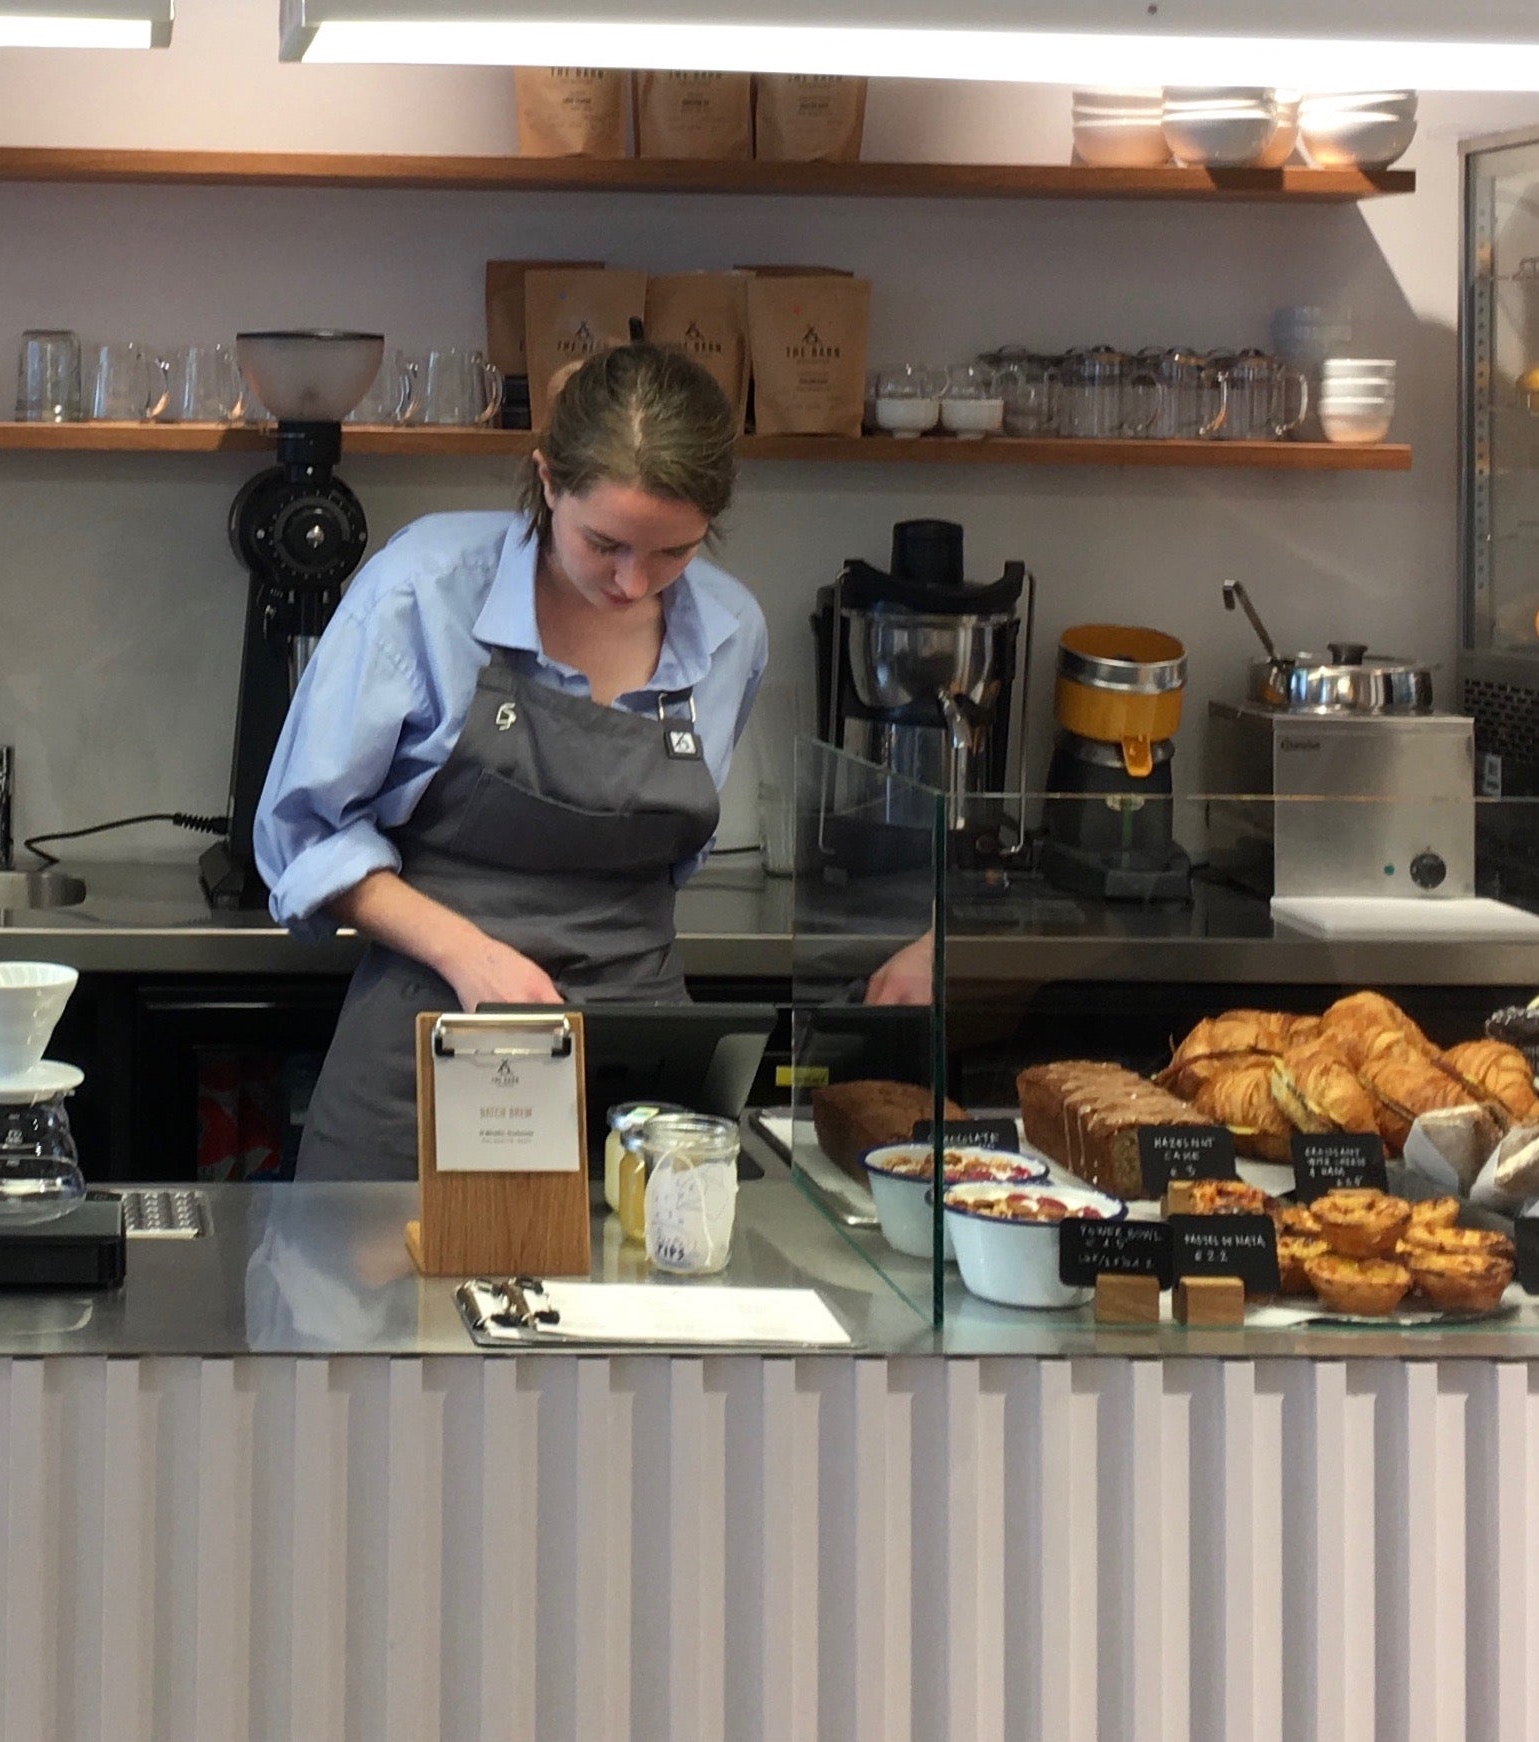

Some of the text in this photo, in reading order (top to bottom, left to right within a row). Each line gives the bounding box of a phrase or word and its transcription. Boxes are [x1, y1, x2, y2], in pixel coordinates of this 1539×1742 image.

[550, 67, 604, 79] THE BARN
[557, 340, 576, 352] THE
[786, 346, 840, 358] THE BARN
[509, 1106, 532, 1118] BREW
[1154, 1136, 1215, 1149] HAZELNUT
[1164, 1151, 1200, 1161] CAKE
[1305, 1146, 1361, 1158] CROISSANT
